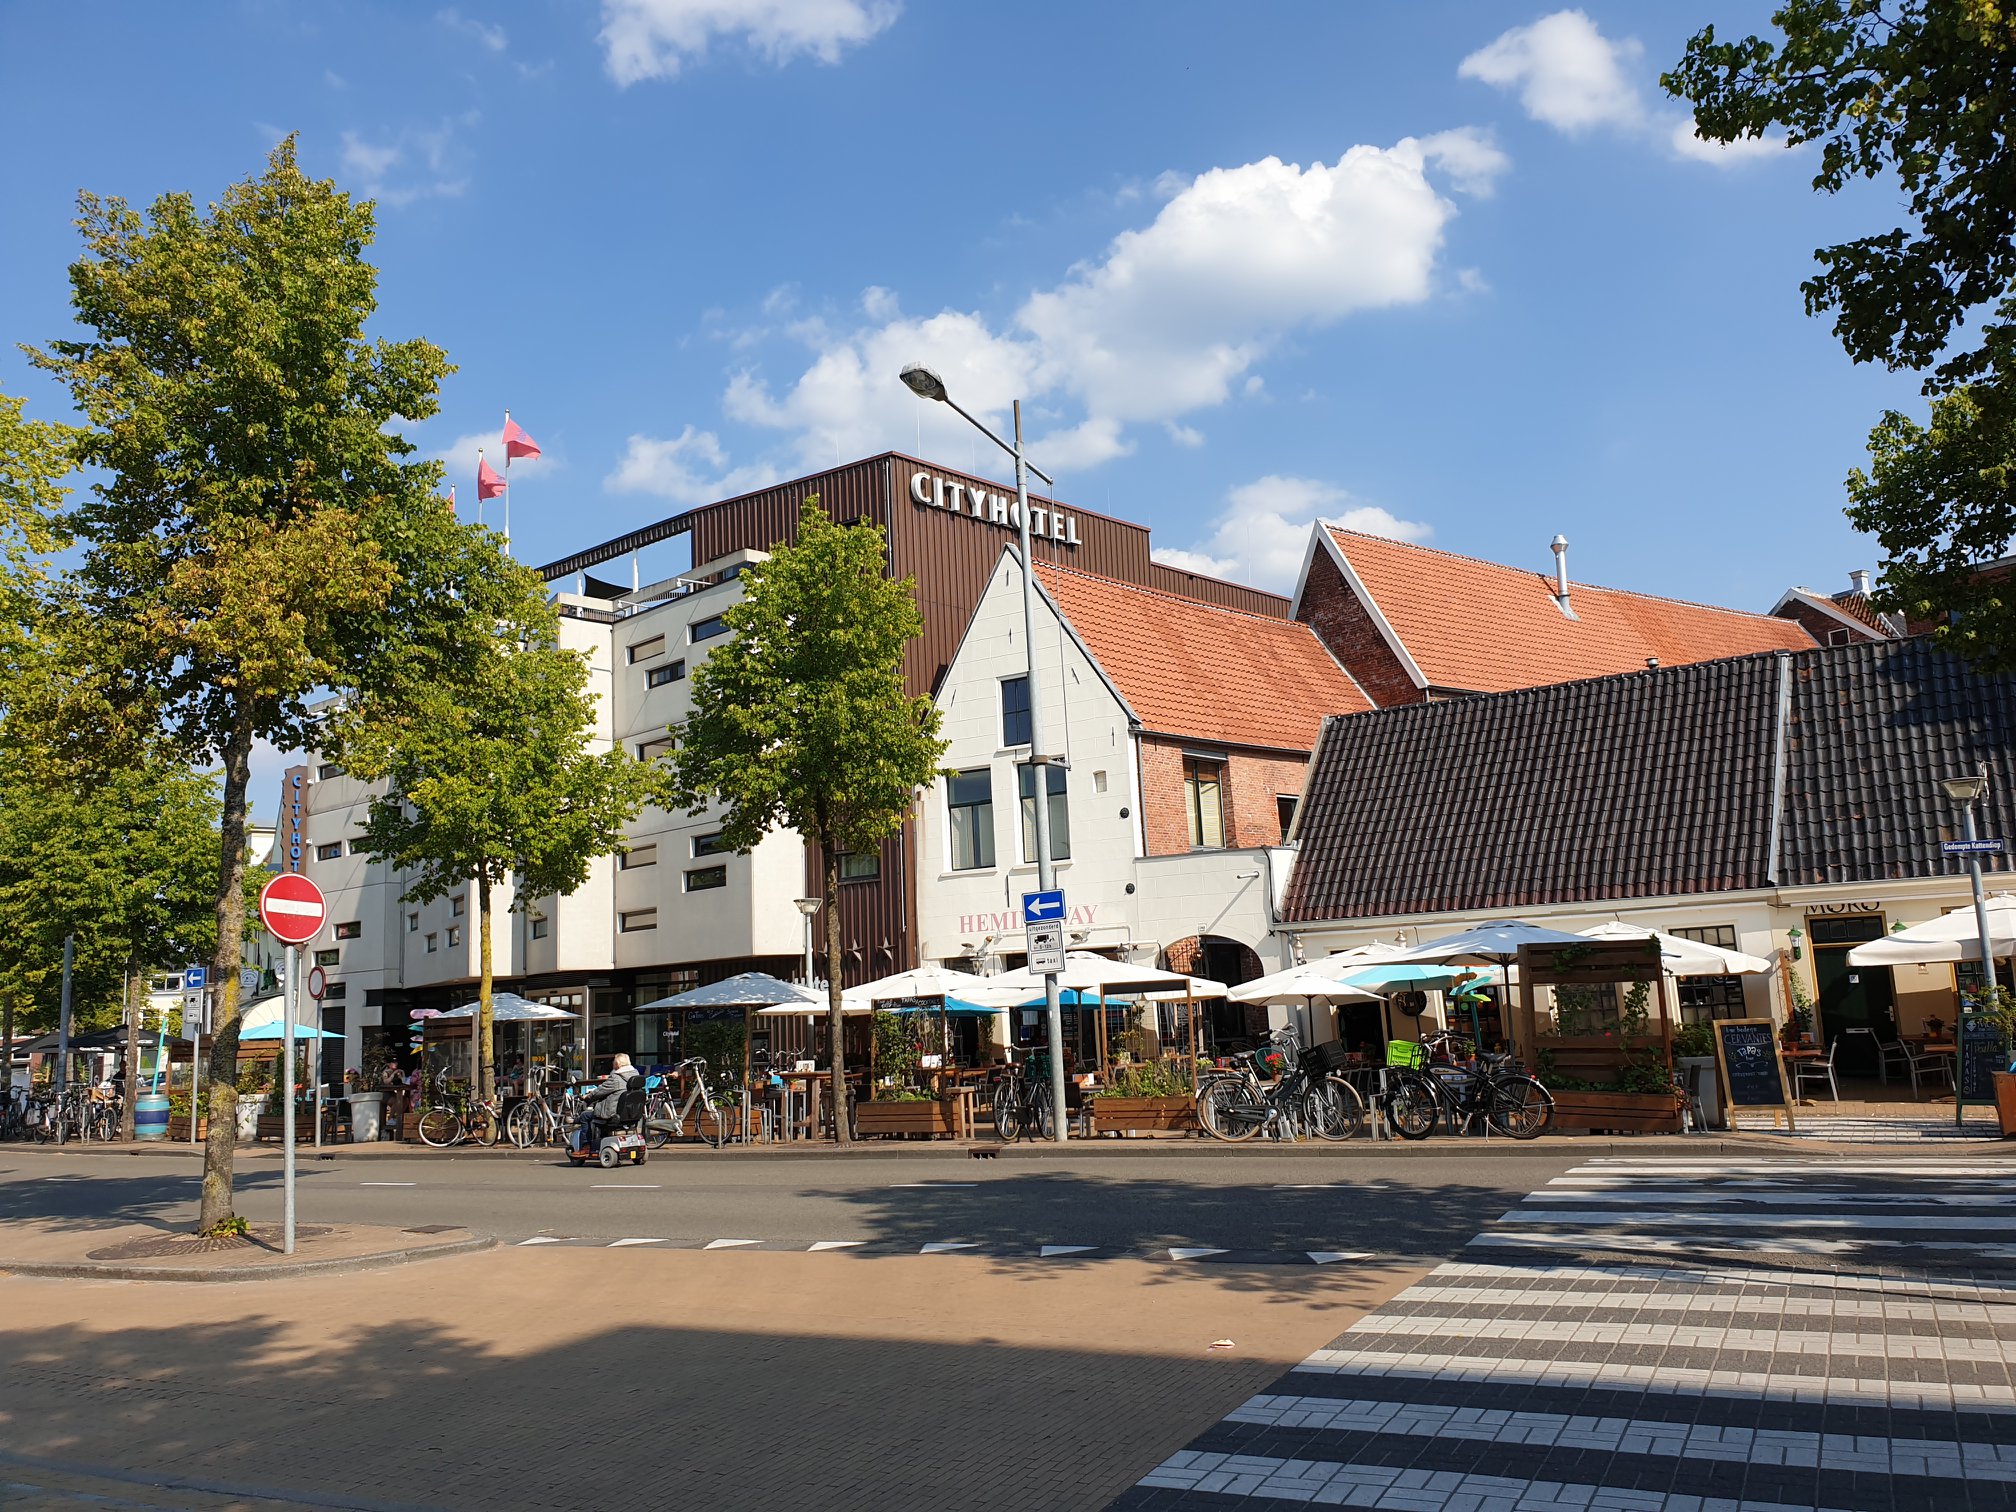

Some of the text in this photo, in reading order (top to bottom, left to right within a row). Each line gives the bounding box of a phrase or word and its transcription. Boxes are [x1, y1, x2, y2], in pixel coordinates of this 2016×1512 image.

[290, 775, 301, 872] CITYHOT
[1943, 843, 1971, 851] Gedempte
[1724, 1032, 1773, 1045] CERVANTES
